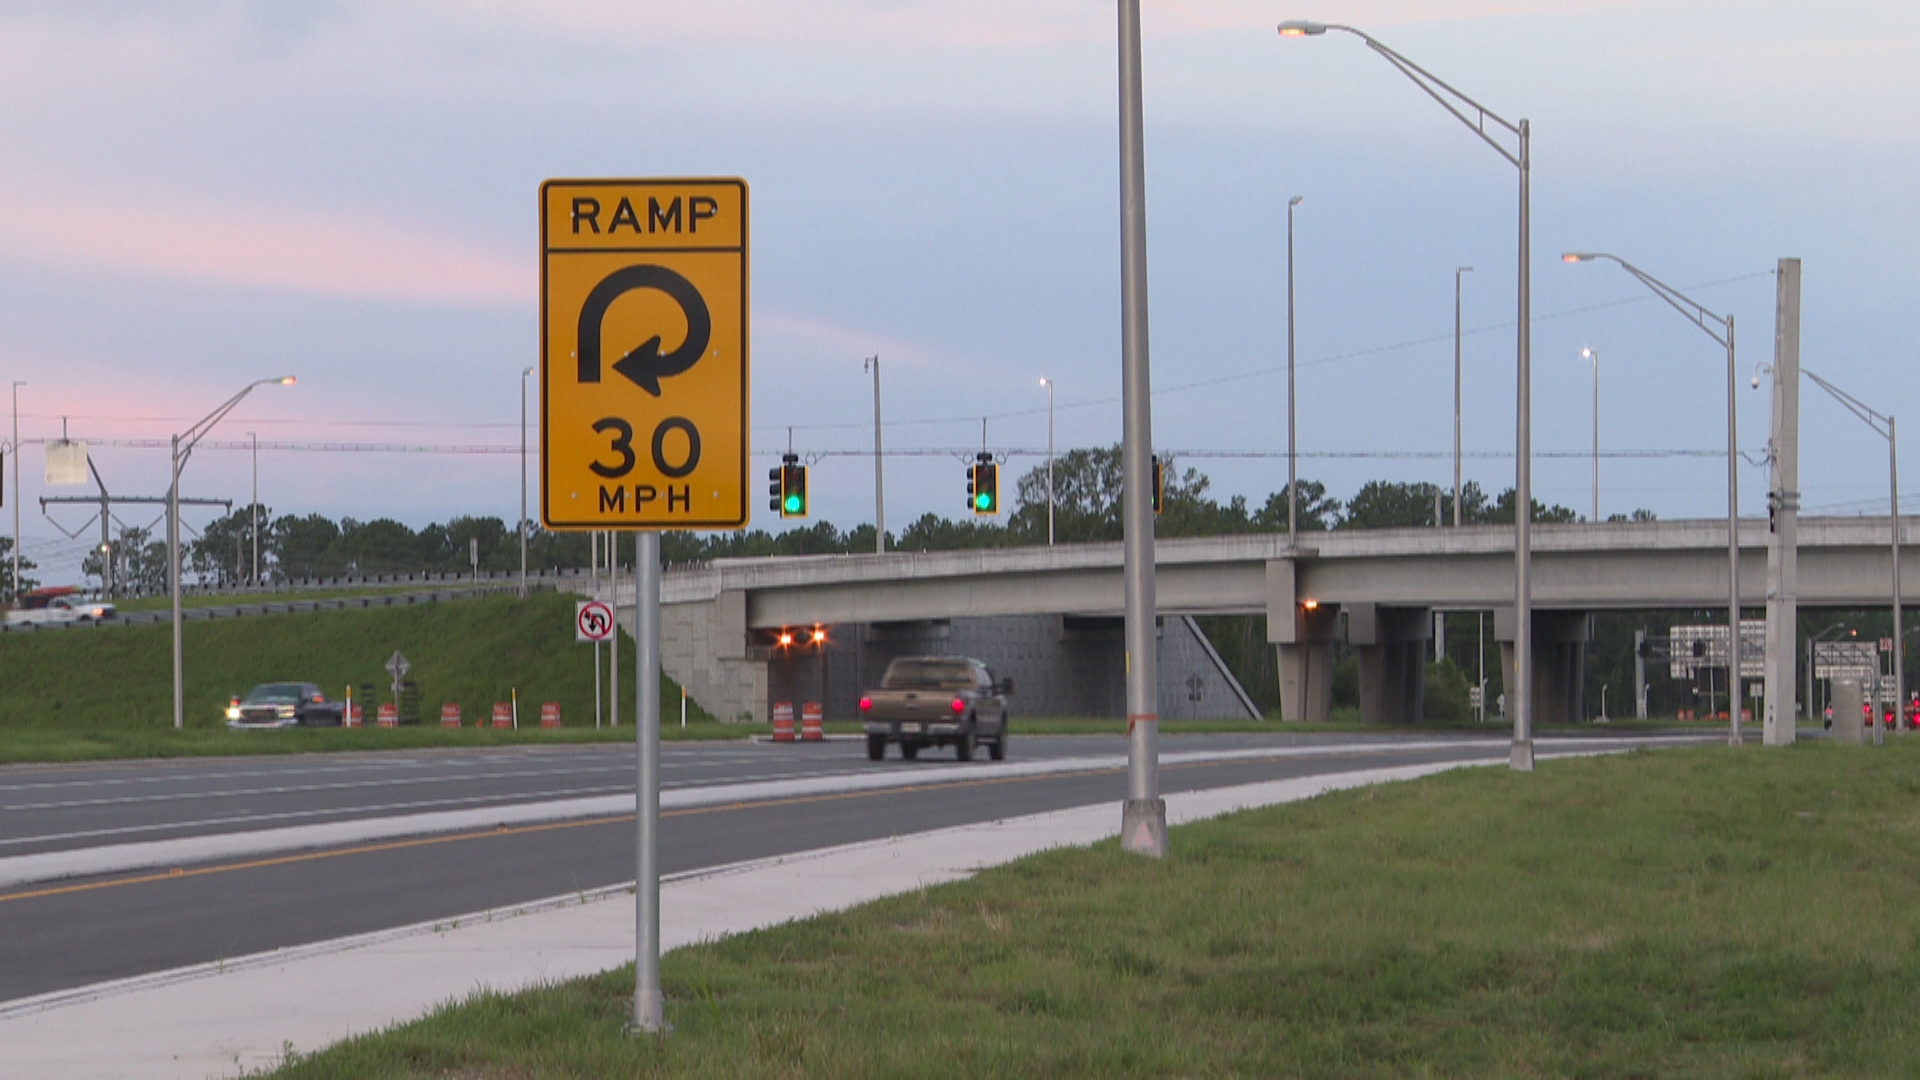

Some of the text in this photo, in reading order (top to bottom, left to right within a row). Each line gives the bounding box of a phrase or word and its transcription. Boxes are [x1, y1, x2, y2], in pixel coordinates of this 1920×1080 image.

[572, 196, 718, 234] RAMP
[588, 416, 701, 479] 30
[599, 484, 690, 513] MPH
